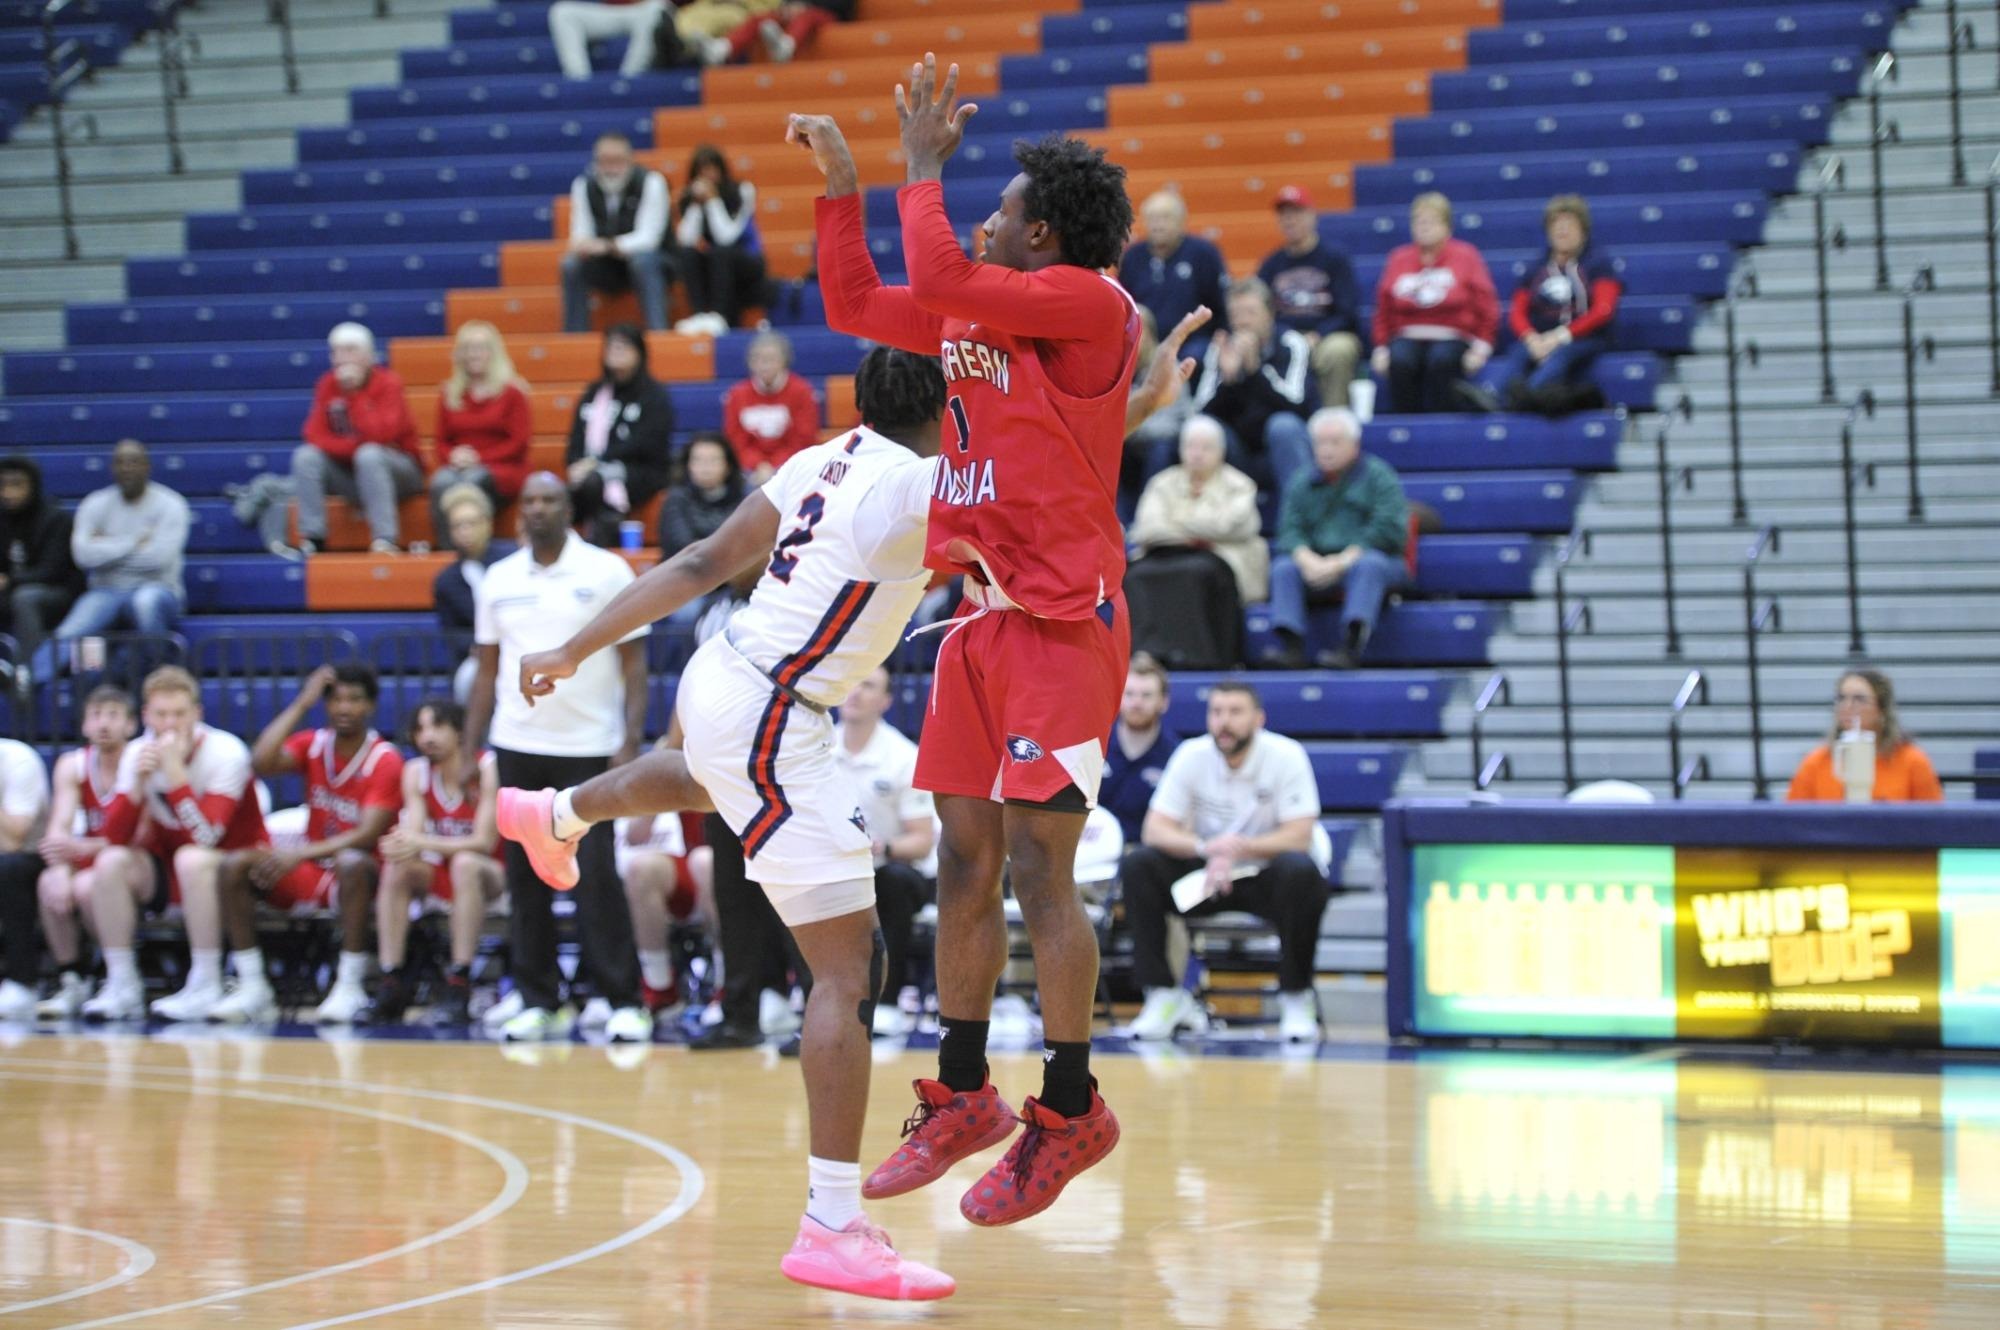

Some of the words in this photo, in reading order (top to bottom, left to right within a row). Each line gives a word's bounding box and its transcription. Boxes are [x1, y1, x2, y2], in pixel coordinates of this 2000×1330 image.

[949, 395, 970, 453] 1
[768, 490, 826, 586] 2
[1691, 883, 1850, 941] WHO'S
